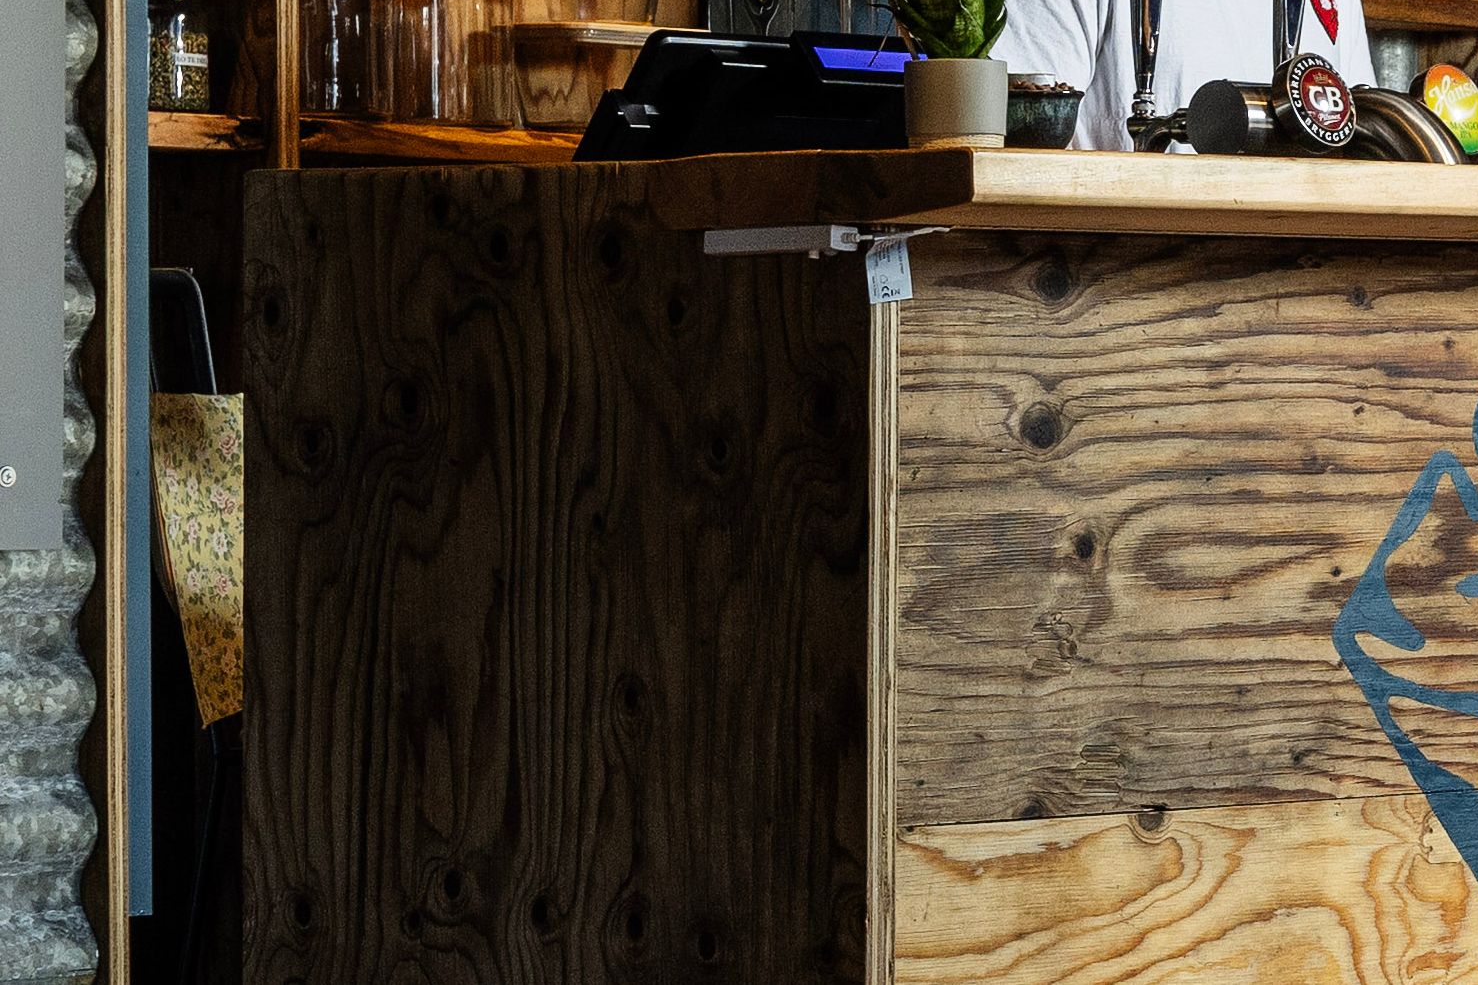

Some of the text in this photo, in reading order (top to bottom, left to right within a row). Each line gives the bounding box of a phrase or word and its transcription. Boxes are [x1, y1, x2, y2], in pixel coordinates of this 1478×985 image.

[1291, 58, 1347, 108] CHRISTIANS
[1308, 85, 1344, 112] CB
[1305, 117, 1353, 141] BRYGGERI
[1450, 121, 1478, 131] MANGO
